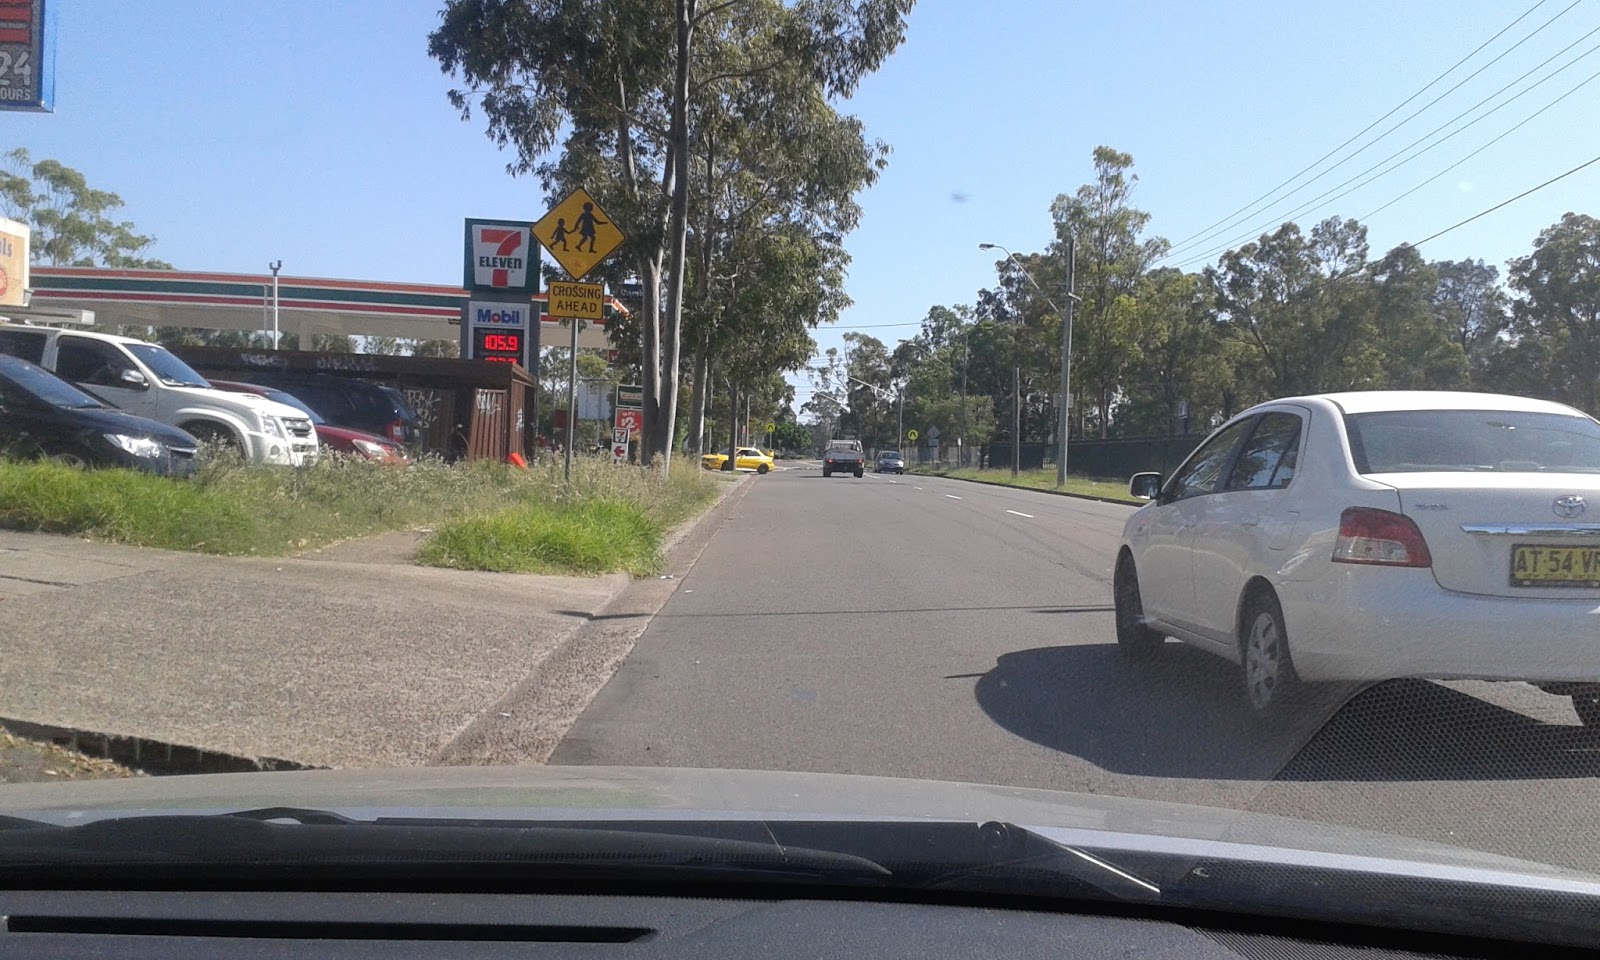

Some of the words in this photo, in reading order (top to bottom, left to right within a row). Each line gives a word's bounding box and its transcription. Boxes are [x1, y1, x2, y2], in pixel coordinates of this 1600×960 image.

[0, 51, 32, 86] 24
[0, 87, 31, 100] OURS
[480, 229, 522, 288] 7
[552, 285, 601, 300] CROSSING
[556, 300, 597, 313] AHEAD
[477, 308, 520, 324] Mobil
[485, 335, 518, 351] 105.9
